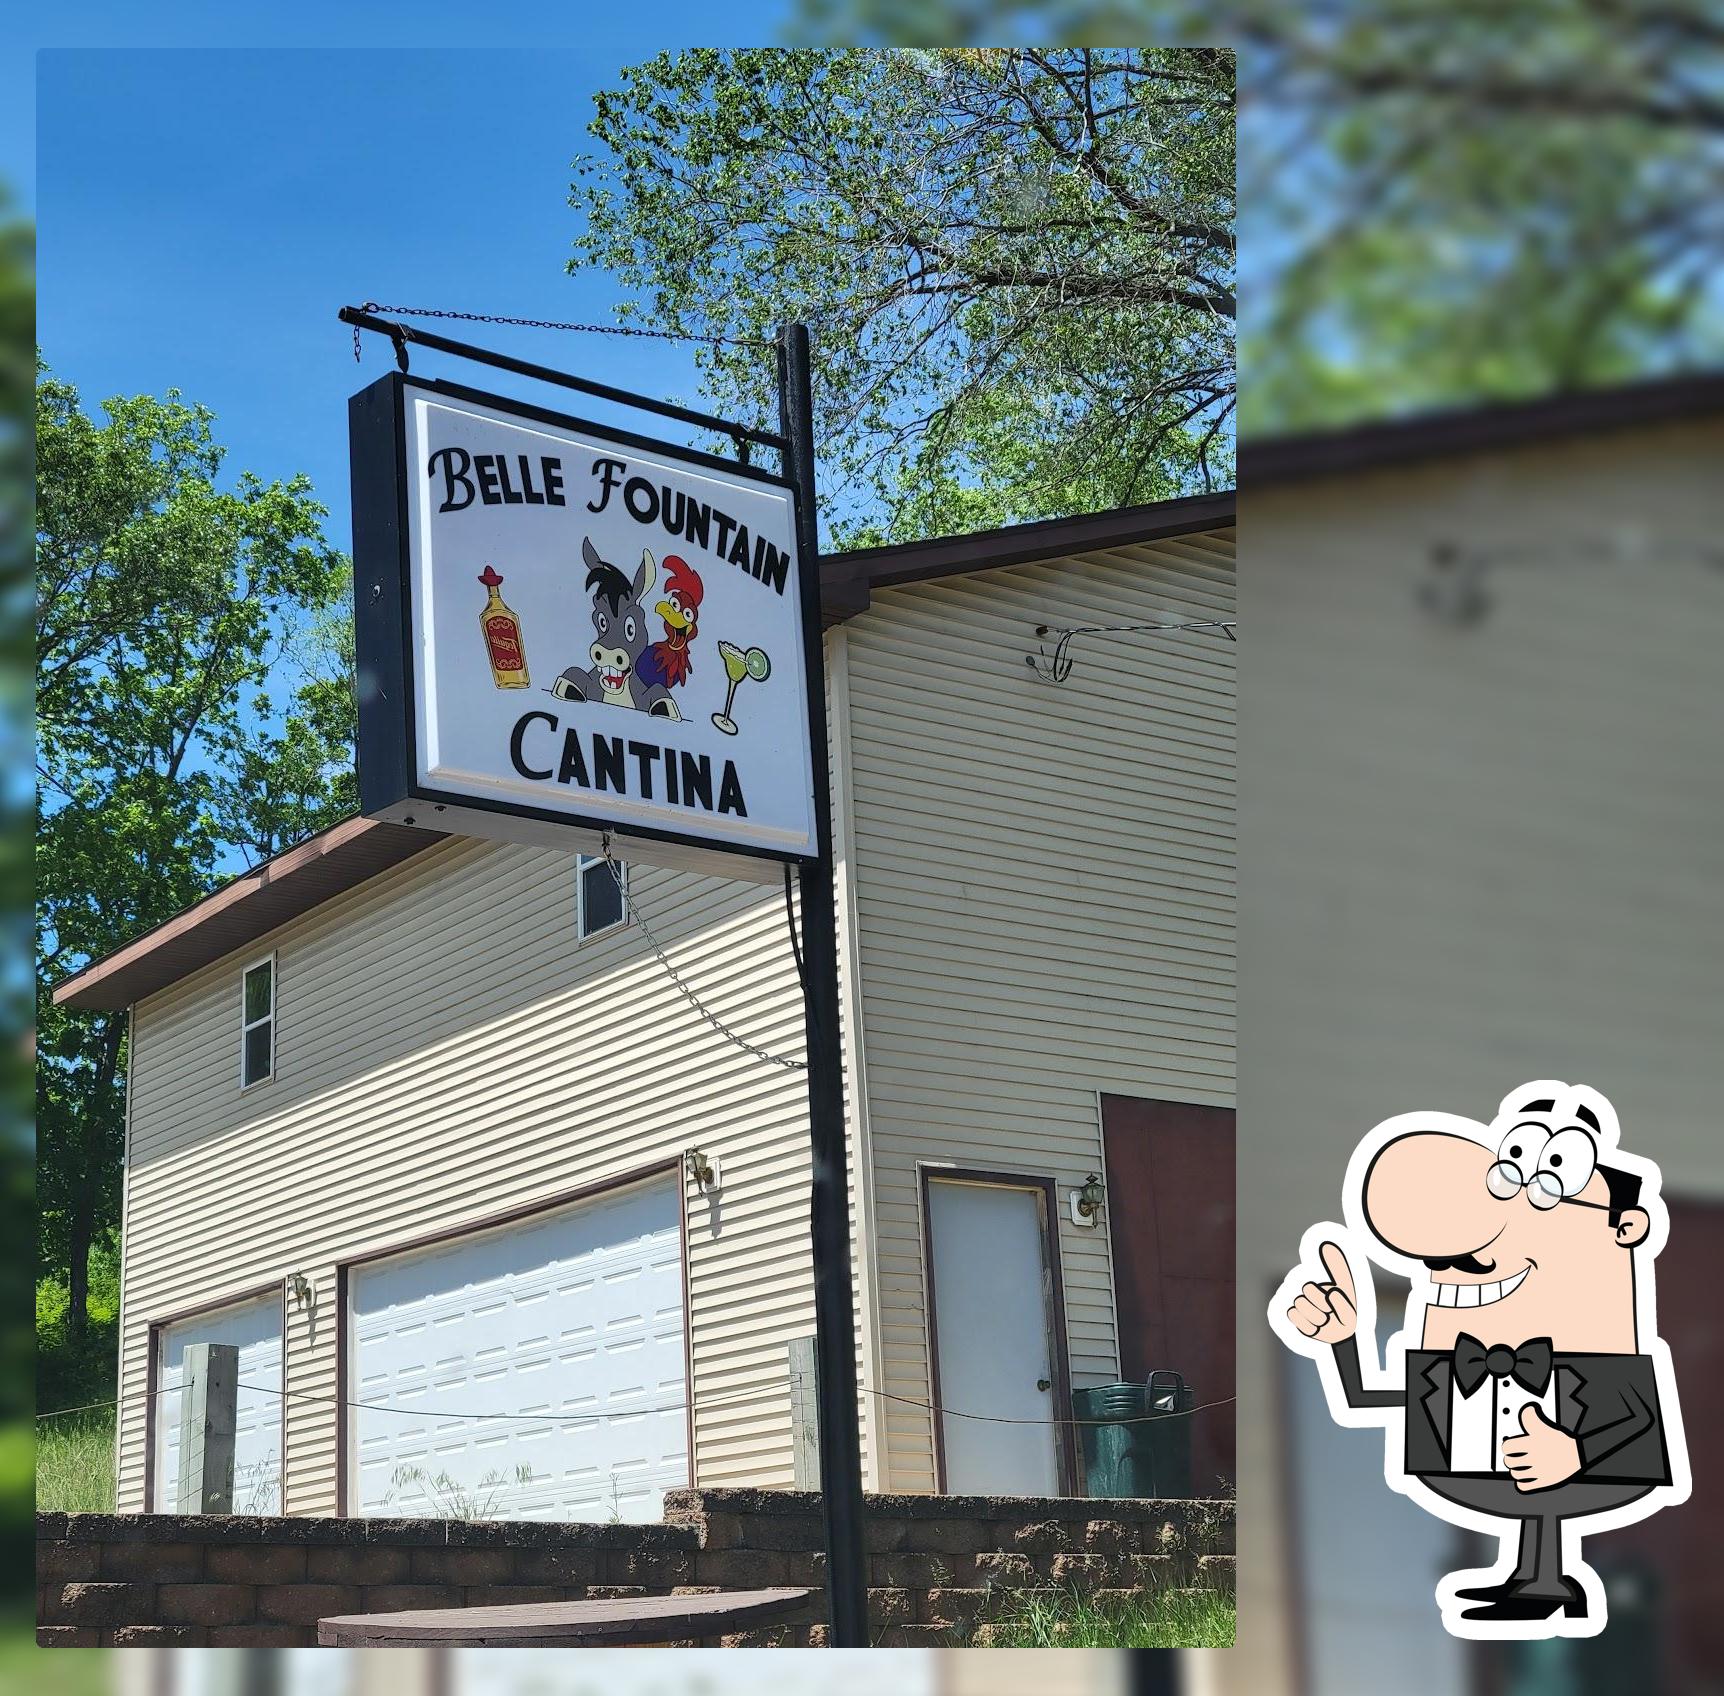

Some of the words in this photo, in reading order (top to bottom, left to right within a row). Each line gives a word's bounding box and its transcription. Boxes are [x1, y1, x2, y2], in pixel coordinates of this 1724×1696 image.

[428, 447, 566, 513] BELLE
[586, 458, 791, 596] FOUNTAIN
[509, 711, 748, 818] CANTINA
